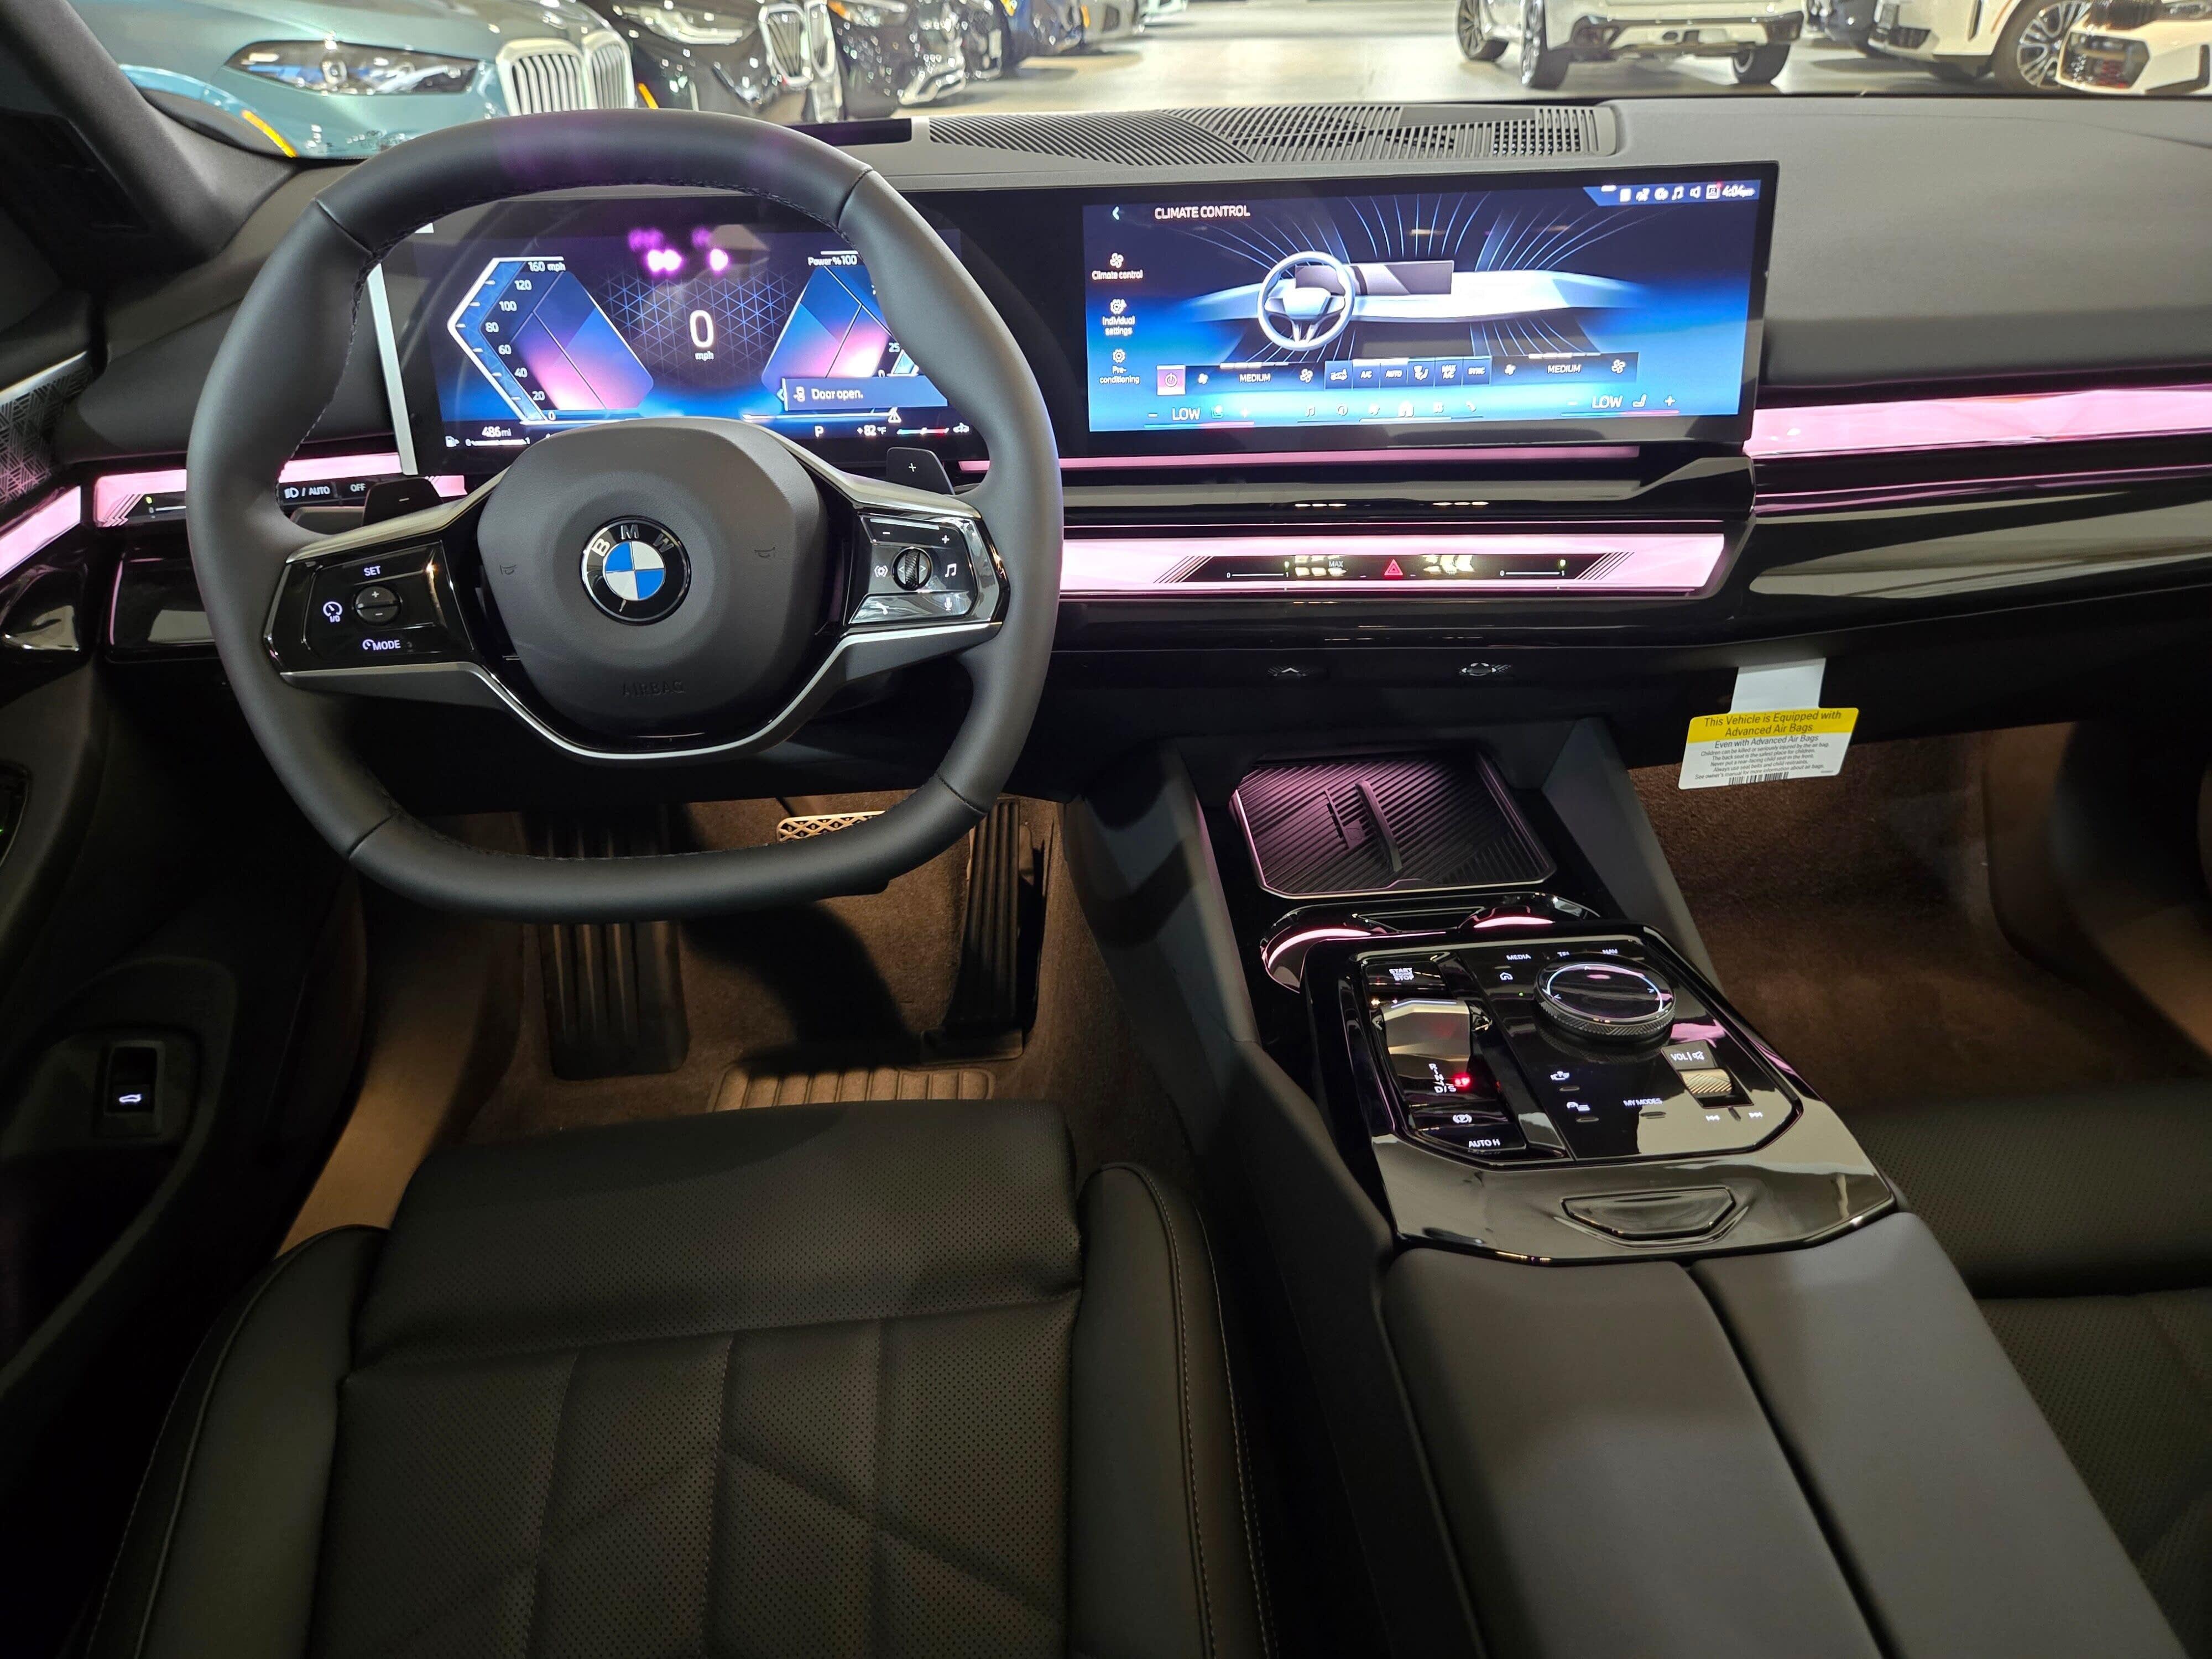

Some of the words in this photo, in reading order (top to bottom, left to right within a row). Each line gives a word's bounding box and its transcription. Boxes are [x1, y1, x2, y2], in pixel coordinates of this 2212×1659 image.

[1155, 206, 1199, 219] CLIMATE
[1201, 205, 1250, 218] CONTROL
[808, 257, 832, 265] Power
[528, 262, 545, 272] 160
[547, 263, 566, 272] mph
[1092, 270, 1118, 280] Climate
[1118, 269, 1143, 279] control
[515, 280, 532, 291] 120
[499, 301, 517, 311] 100
[1102, 316, 1135, 326] Individual
[486, 322, 499, 333] 80
[689, 310, 714, 348] 0
[1105, 327, 1133, 336] settings
[498, 345, 511, 355] 60
[889, 342, 900, 352] 25
[695, 352, 714, 361] mph
[515, 368, 528, 378] 40
[1112, 365, 1126, 374] Pre-
[1385, 370, 1403, 378] AUTO
[1547, 364, 1581, 374] MEDIUM
[1099, 375, 1140, 384] conditioning
[1239, 373, 1271, 383] MEDIUM
[532, 391, 545, 401] 20
[811, 388, 836, 400] Door
[837, 389, 863, 400] open.
[1592, 395, 1623, 409] LOW
[548, 411, 556, 421] 0
[1172, 408, 1201, 420] LOW
[814, 425, 823, 437] P
[309, 487, 330, 495] AUTO
[350, 483, 366, 492] OFF
[591, 524, 676, 557] BMW
[364, 566, 381, 576] SET
[373, 640, 401, 650] MODE
[1704, 718, 1723, 727] This
[1726, 714, 1760, 725] Vehicle
[1762, 713, 1771, 723] is
[1773, 711, 1819, 723] Equipped
[1821, 711, 1841, 719] with
[1725, 725, 1772, 737] Advanced
[1773, 724, 1787, 733] Air
[1789, 723, 1813, 733] Bags
[1715, 740, 1733, 749] Even
[1751, 736, 1787, 745] Advanced
[1800, 734, 1819, 743] Bags
[1670, 1052, 1687, 1061] VOL
[1635, 1098, 1663, 1106] MODES
[1469, 1139, 1492, 1147] AUTO
